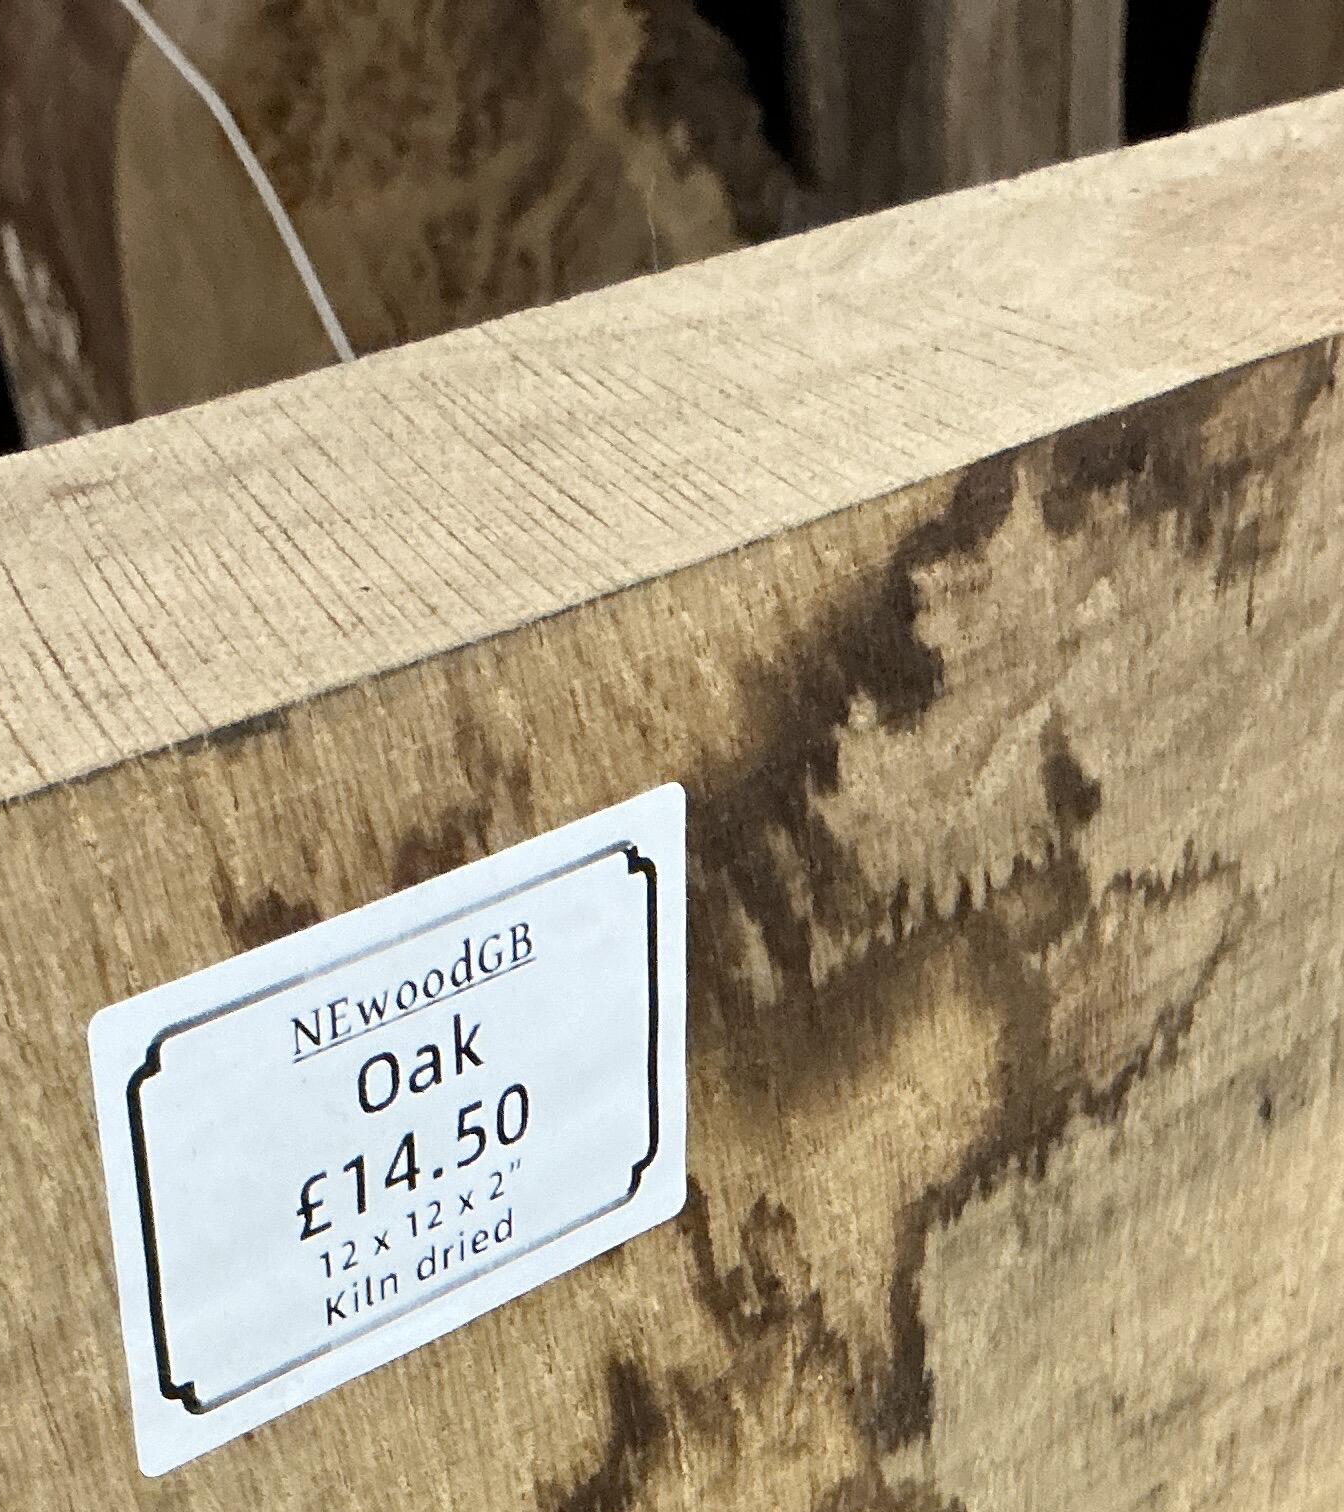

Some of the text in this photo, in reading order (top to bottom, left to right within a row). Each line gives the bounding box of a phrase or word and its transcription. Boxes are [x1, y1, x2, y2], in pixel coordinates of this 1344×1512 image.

[290, 921, 534, 1057] NEwoodGB
[357, 1013, 484, 1114] Oak
[296, 1083, 530, 1242] £14.50
[319, 1157, 522, 1279] 12 x 12 x 2"
[325, 1207, 514, 1327] Kiln dried
